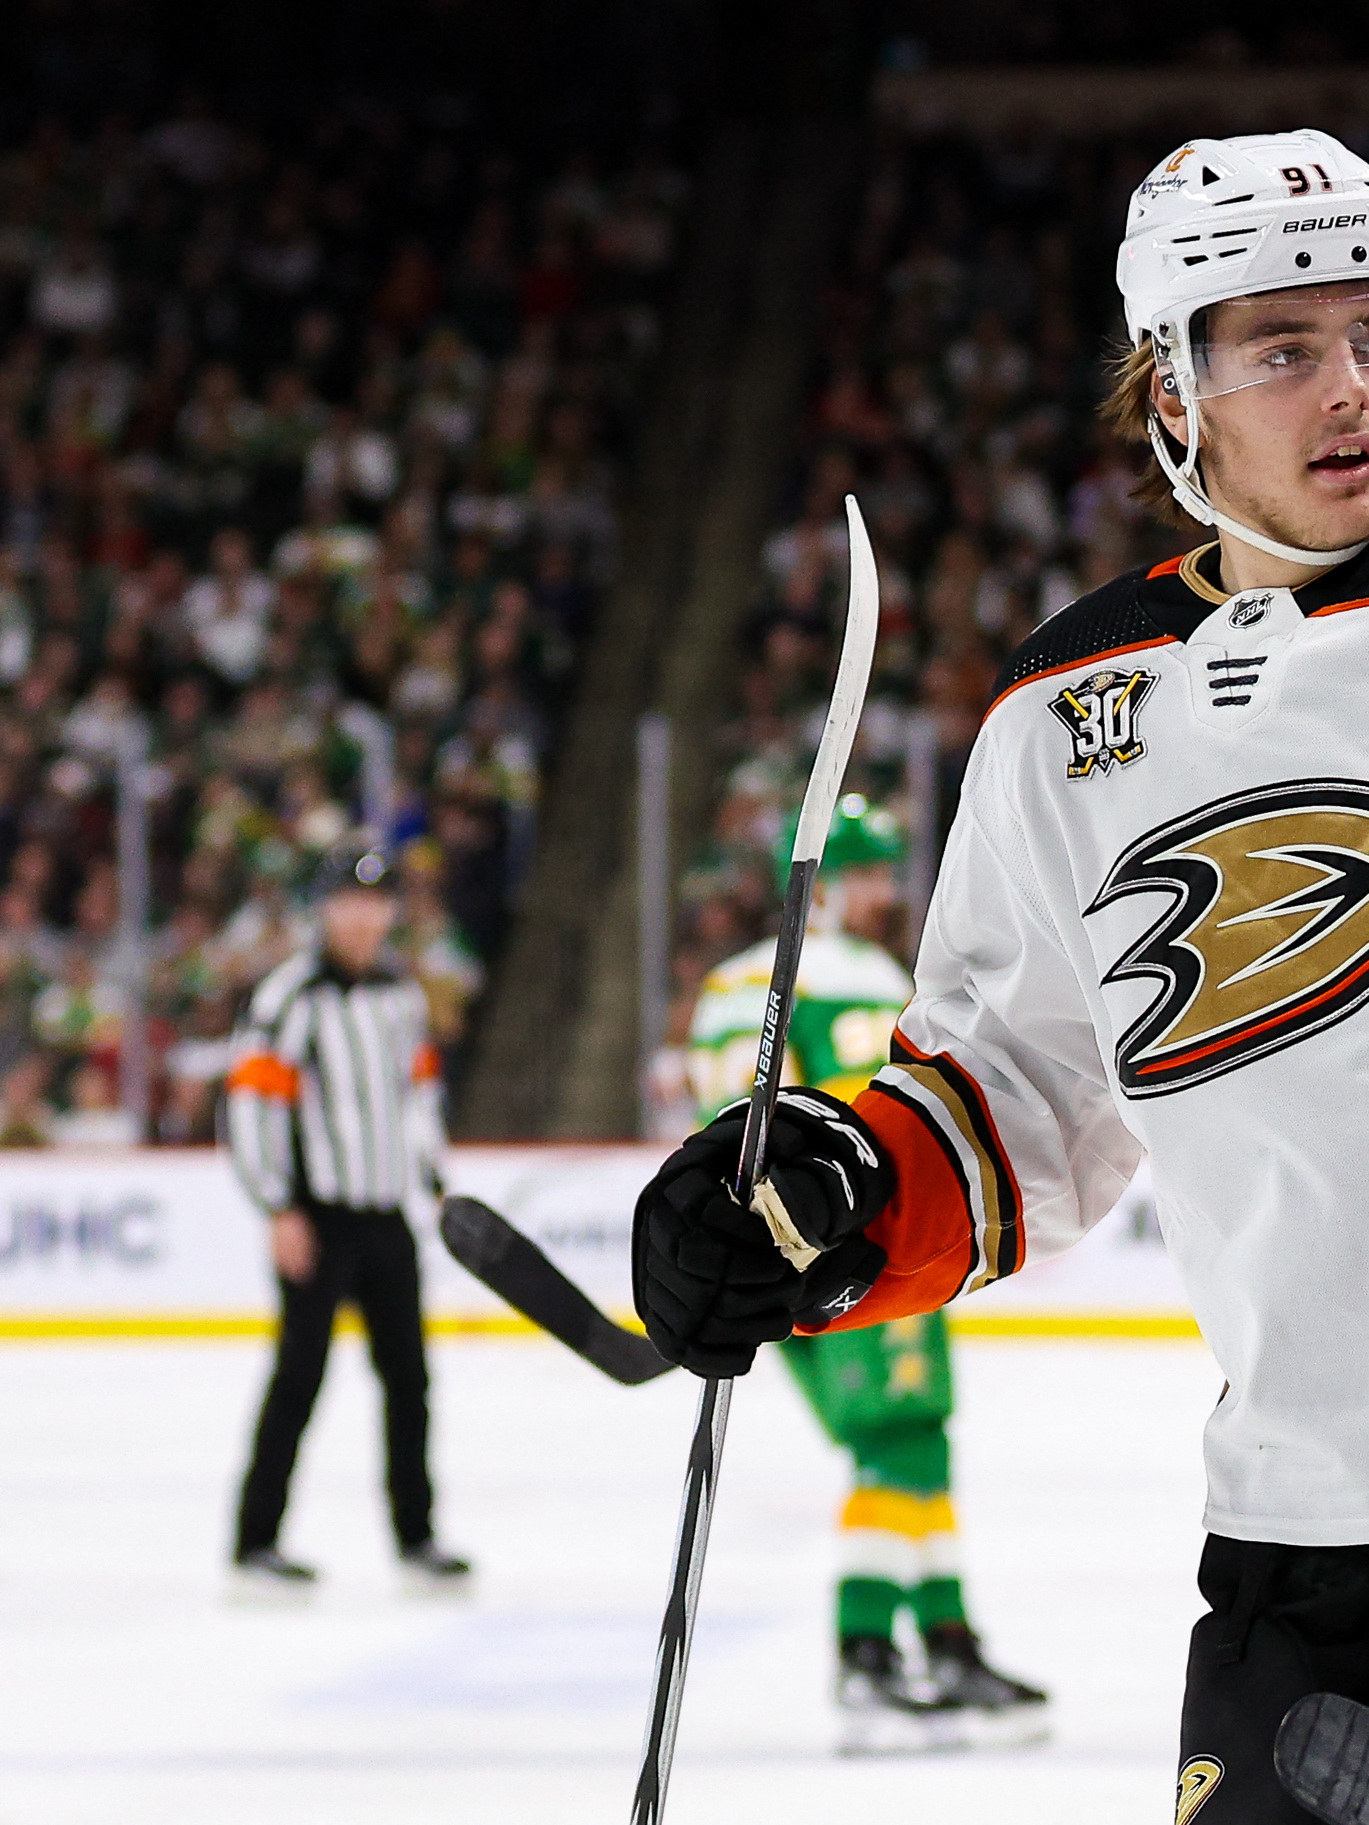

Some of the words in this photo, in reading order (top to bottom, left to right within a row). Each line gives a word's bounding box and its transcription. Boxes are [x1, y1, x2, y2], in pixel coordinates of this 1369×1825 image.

[1278, 163, 1334, 197] 91
[1282, 213, 1367, 235] BAUER
[1073, 686, 1132, 757] 30
[758, 989, 783, 1074] BAUER
